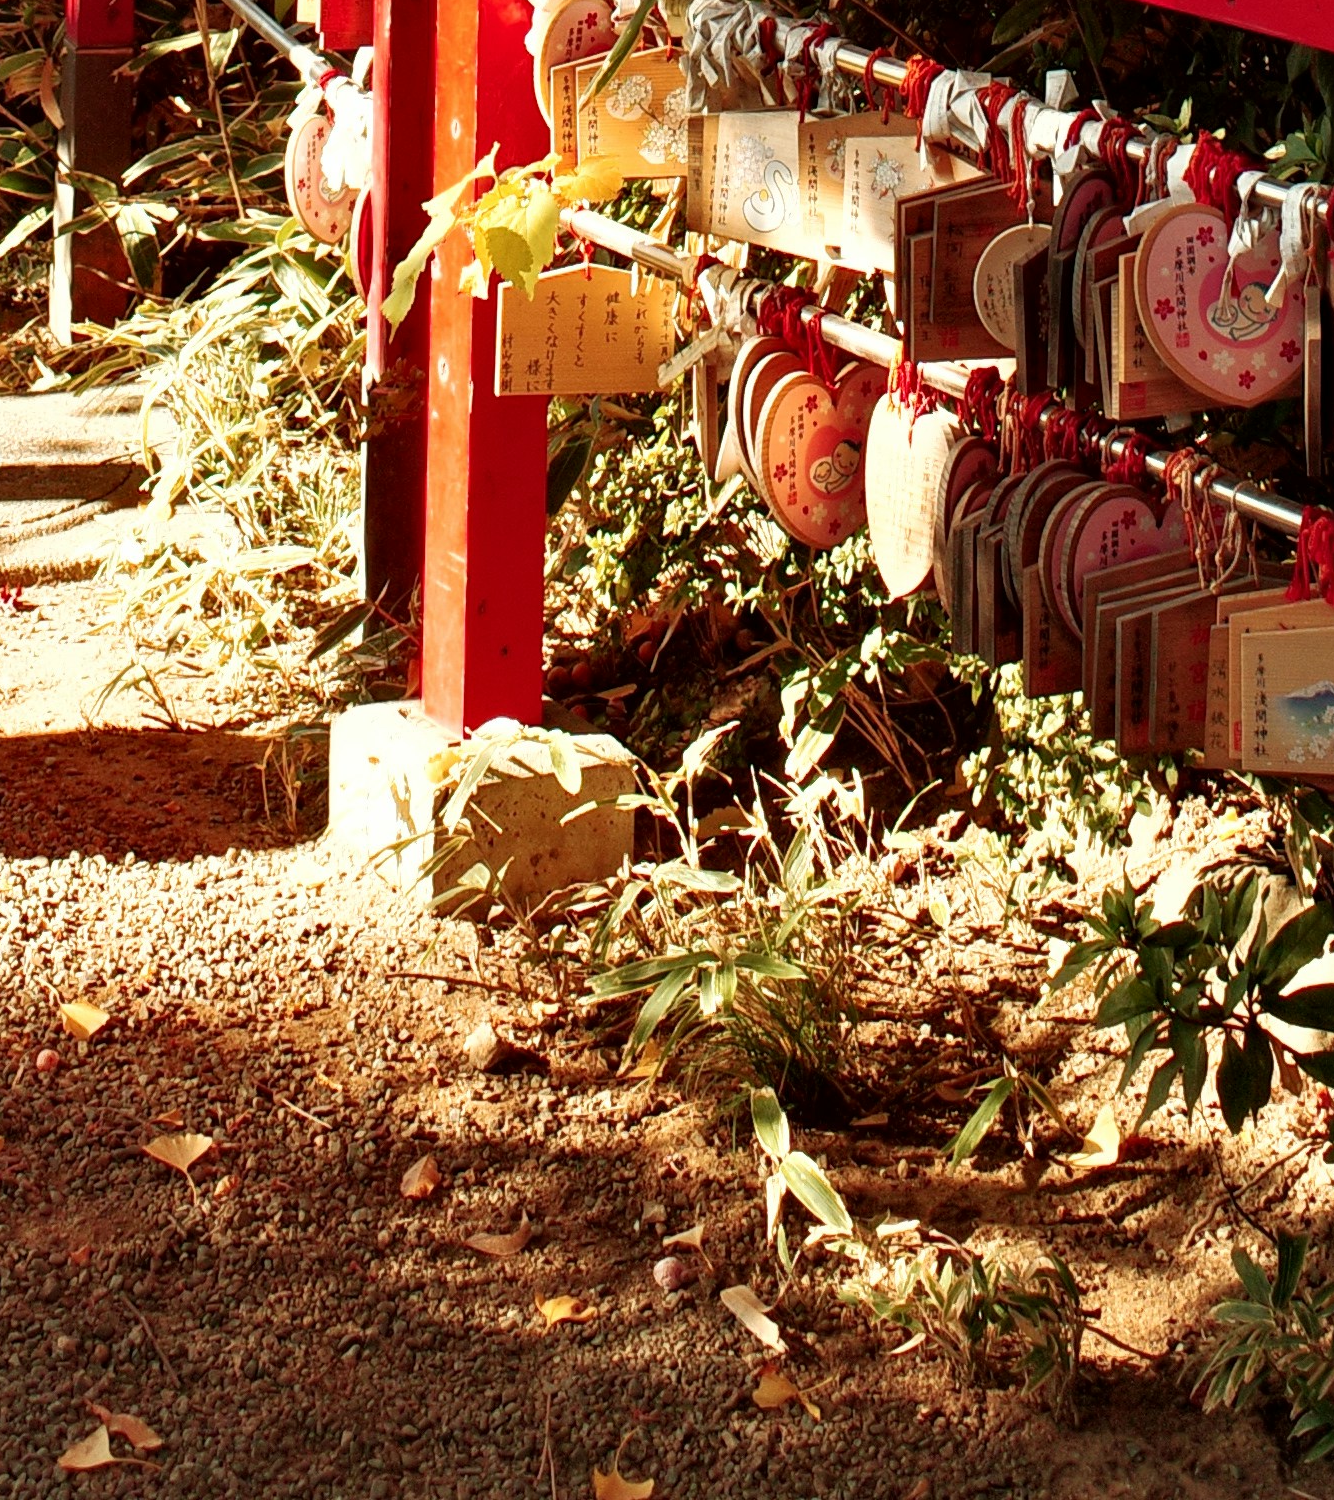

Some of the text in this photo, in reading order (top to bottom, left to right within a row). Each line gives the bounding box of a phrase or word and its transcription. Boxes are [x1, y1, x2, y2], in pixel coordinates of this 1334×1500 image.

[807, 133, 819, 218] 多摩川浅間神社
[849, 149, 861, 233] 多摩川浅間神社
[1174, 246, 1187, 332] 多摩川浅間神社
[1185, 236, 1197, 277] 田園調布
[574, 293, 590, 368] すくすくと
[604, 291, 621, 343] 健康に
[787, 415, 798, 493] 多摩川浅間神社
[1255, 652, 1268, 758] 多摩川浅間神社
